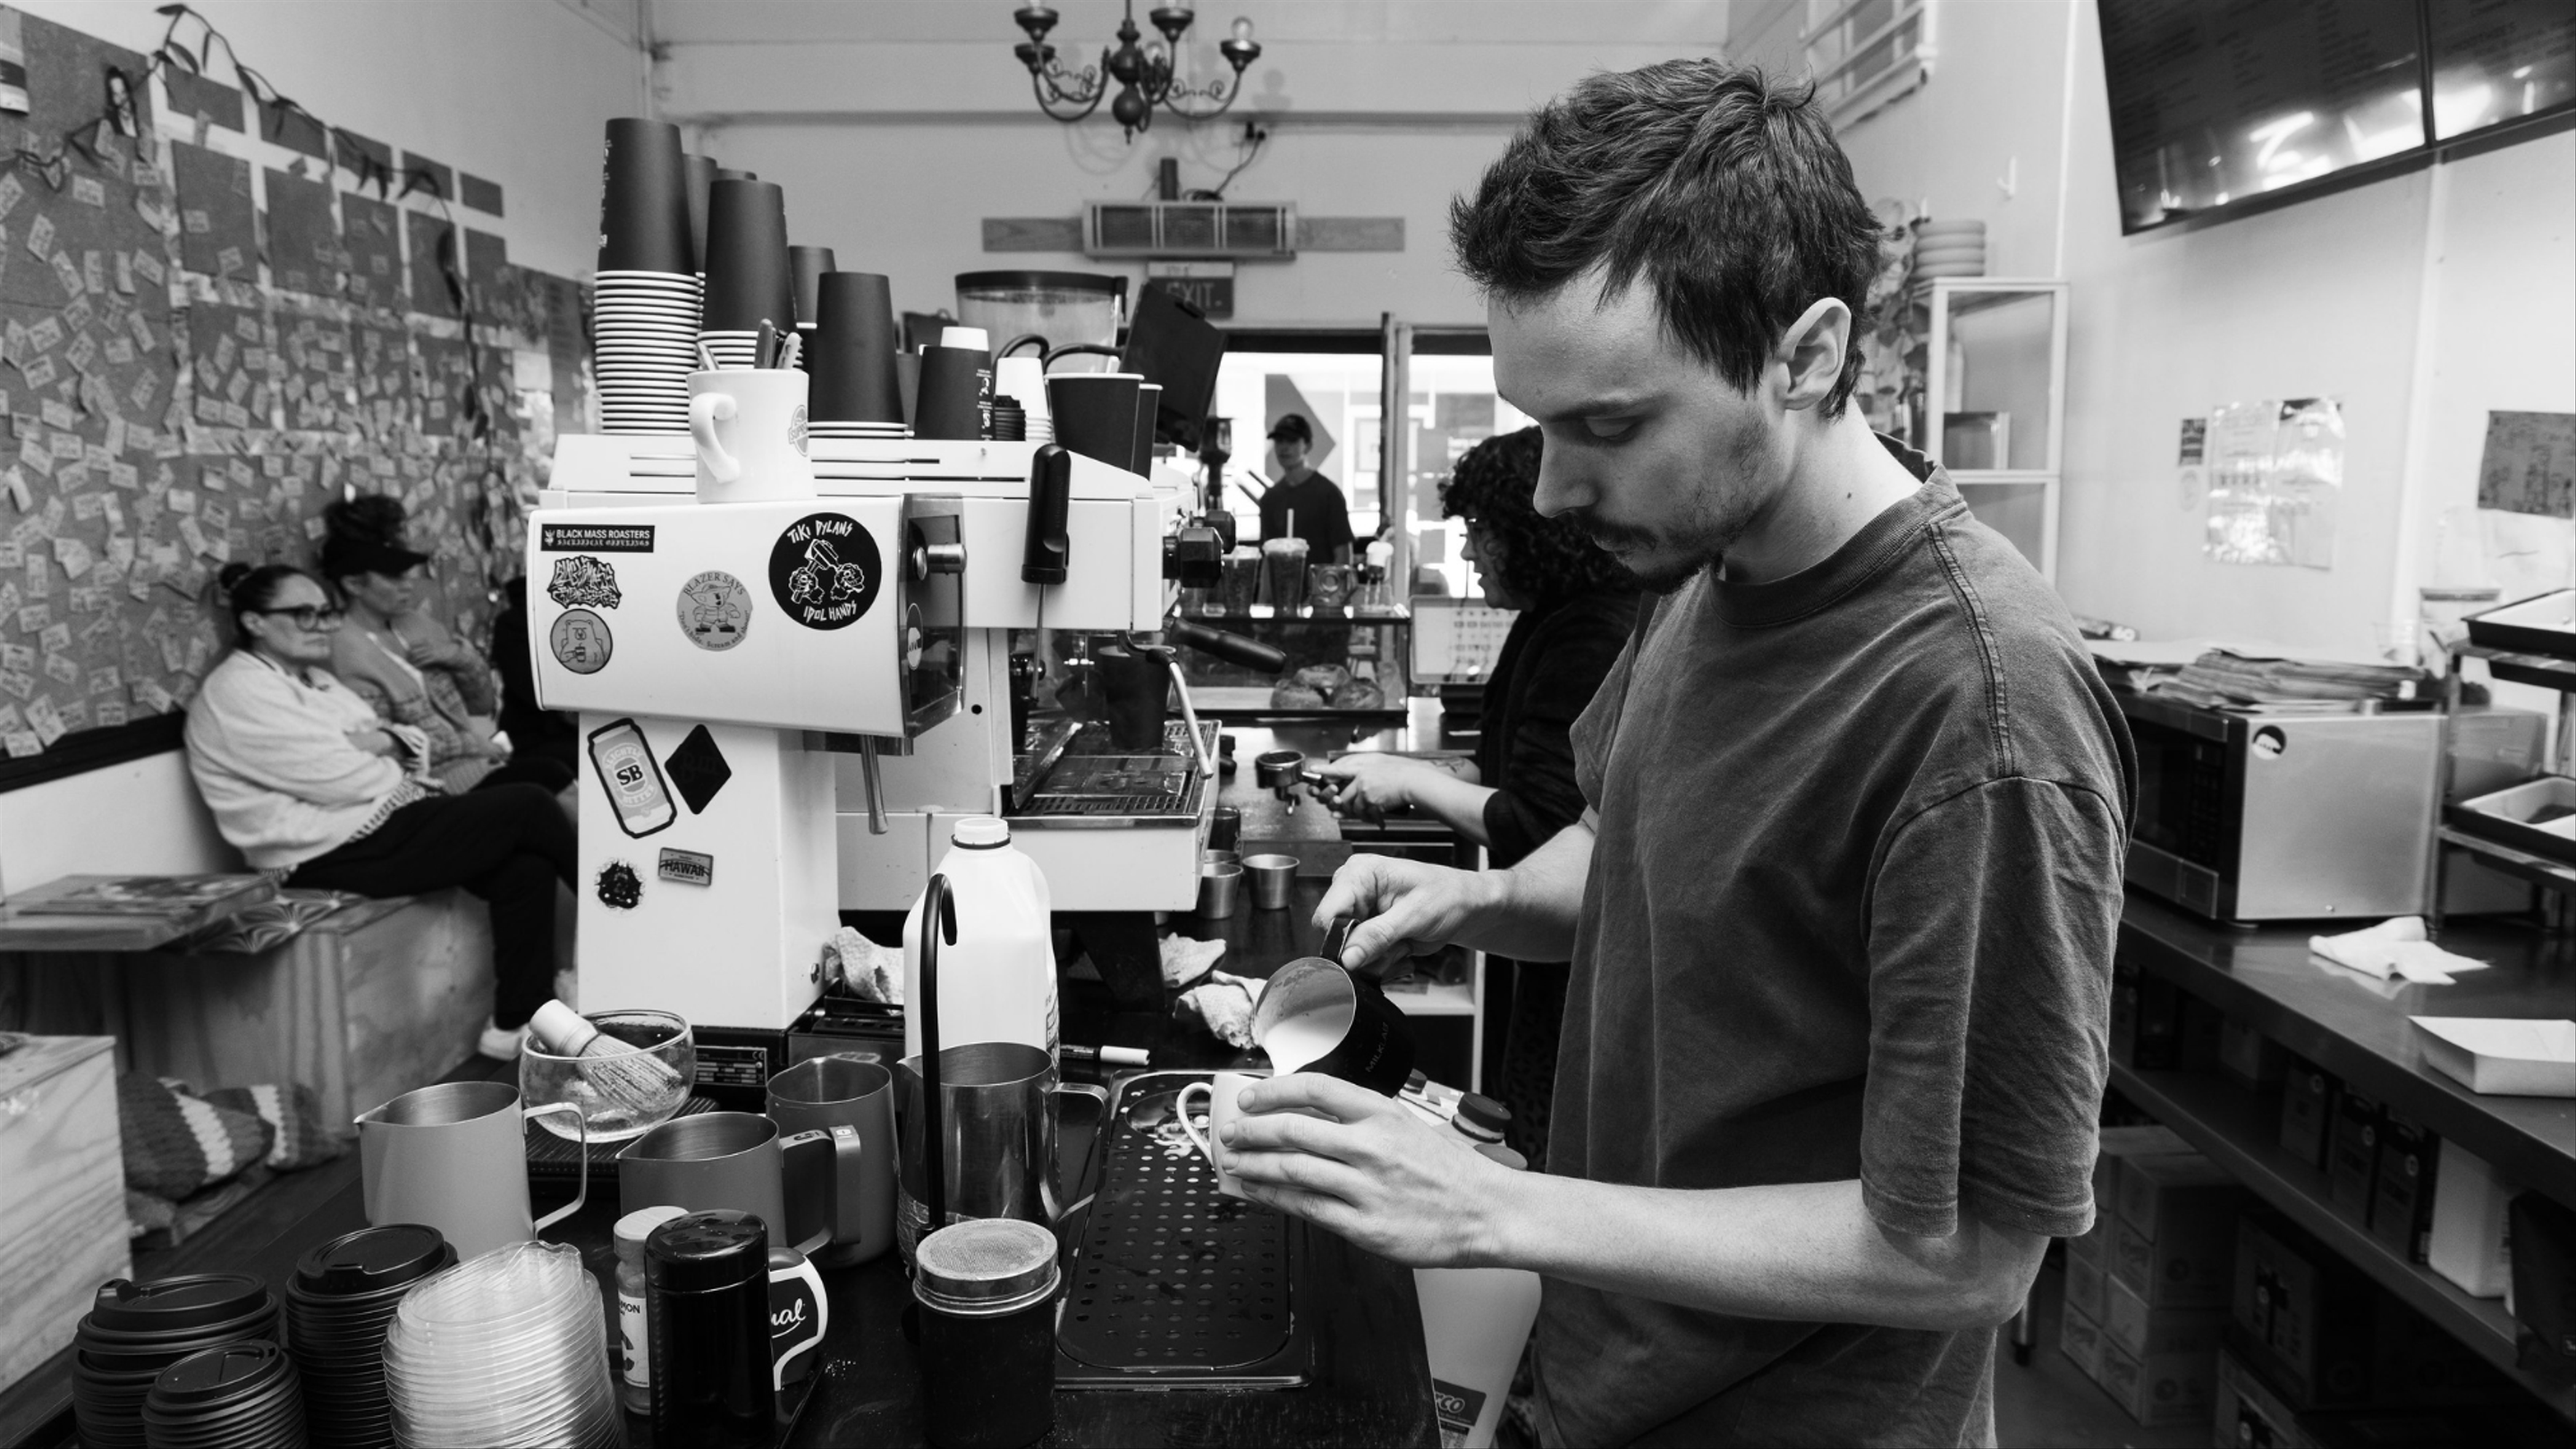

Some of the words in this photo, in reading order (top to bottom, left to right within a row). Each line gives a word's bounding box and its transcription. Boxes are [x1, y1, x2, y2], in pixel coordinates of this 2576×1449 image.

[555, 529, 583, 538] BLACK
[584, 530, 607, 538] MASS
[607, 530, 651, 539] ROASTERS
[815, 520, 854, 538] DYLANS
[682, 572, 721, 597] BLAZER
[722, 574, 747, 596] SAYS
[802, 605, 827, 623] IDOL
[828, 599, 858, 622] HANDS
[615, 764, 644, 786] SB
